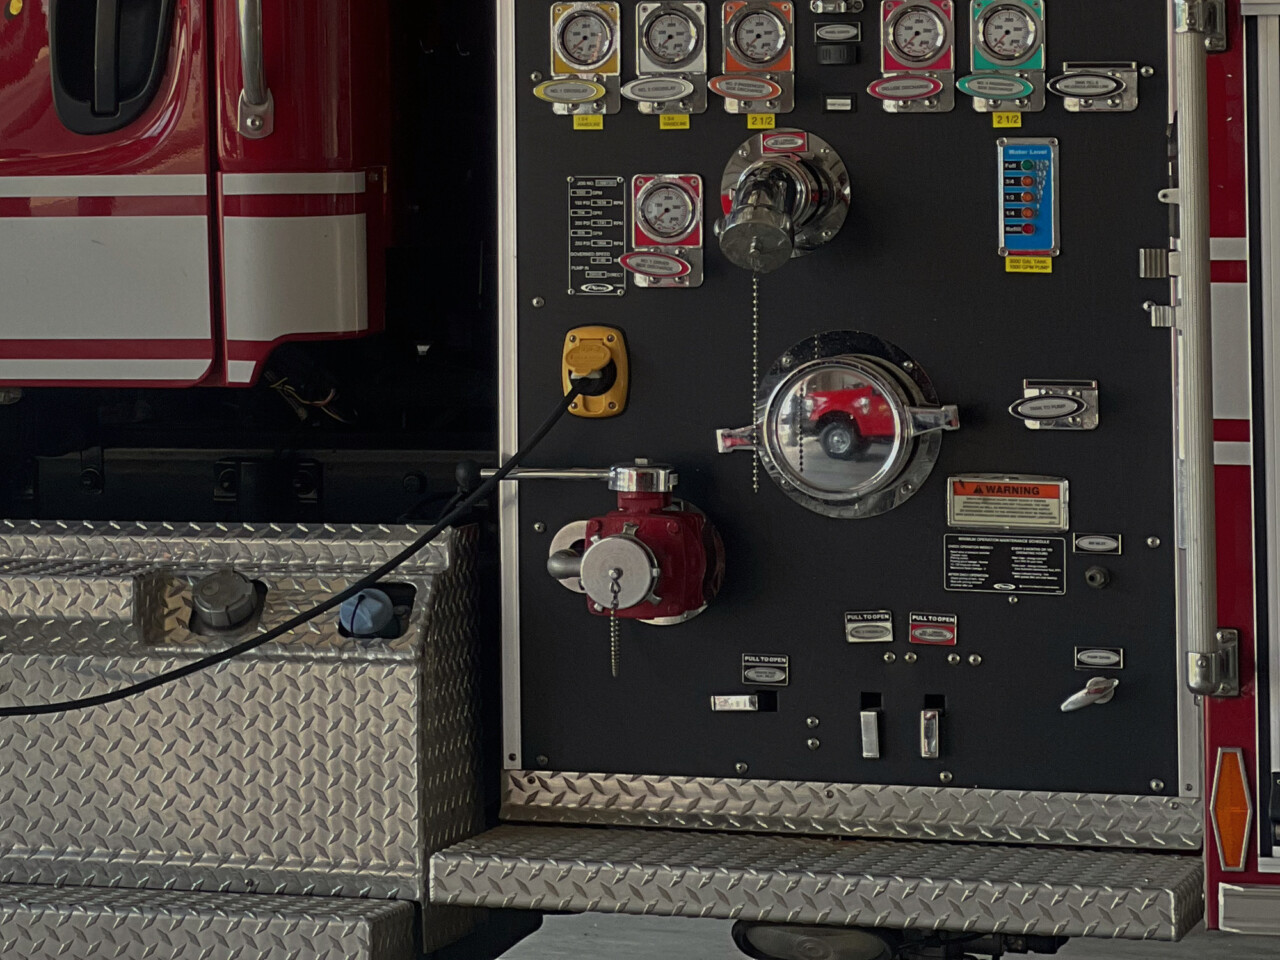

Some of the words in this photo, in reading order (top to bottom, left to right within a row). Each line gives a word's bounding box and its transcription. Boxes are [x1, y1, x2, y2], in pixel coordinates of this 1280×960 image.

[751, 116, 757, 125] 2
[759, 116, 773, 125] 1/2
[996, 115, 1004, 124] 2
[1005, 115, 1020, 124] 1/2
[985, 485, 1040, 496] WARNING
